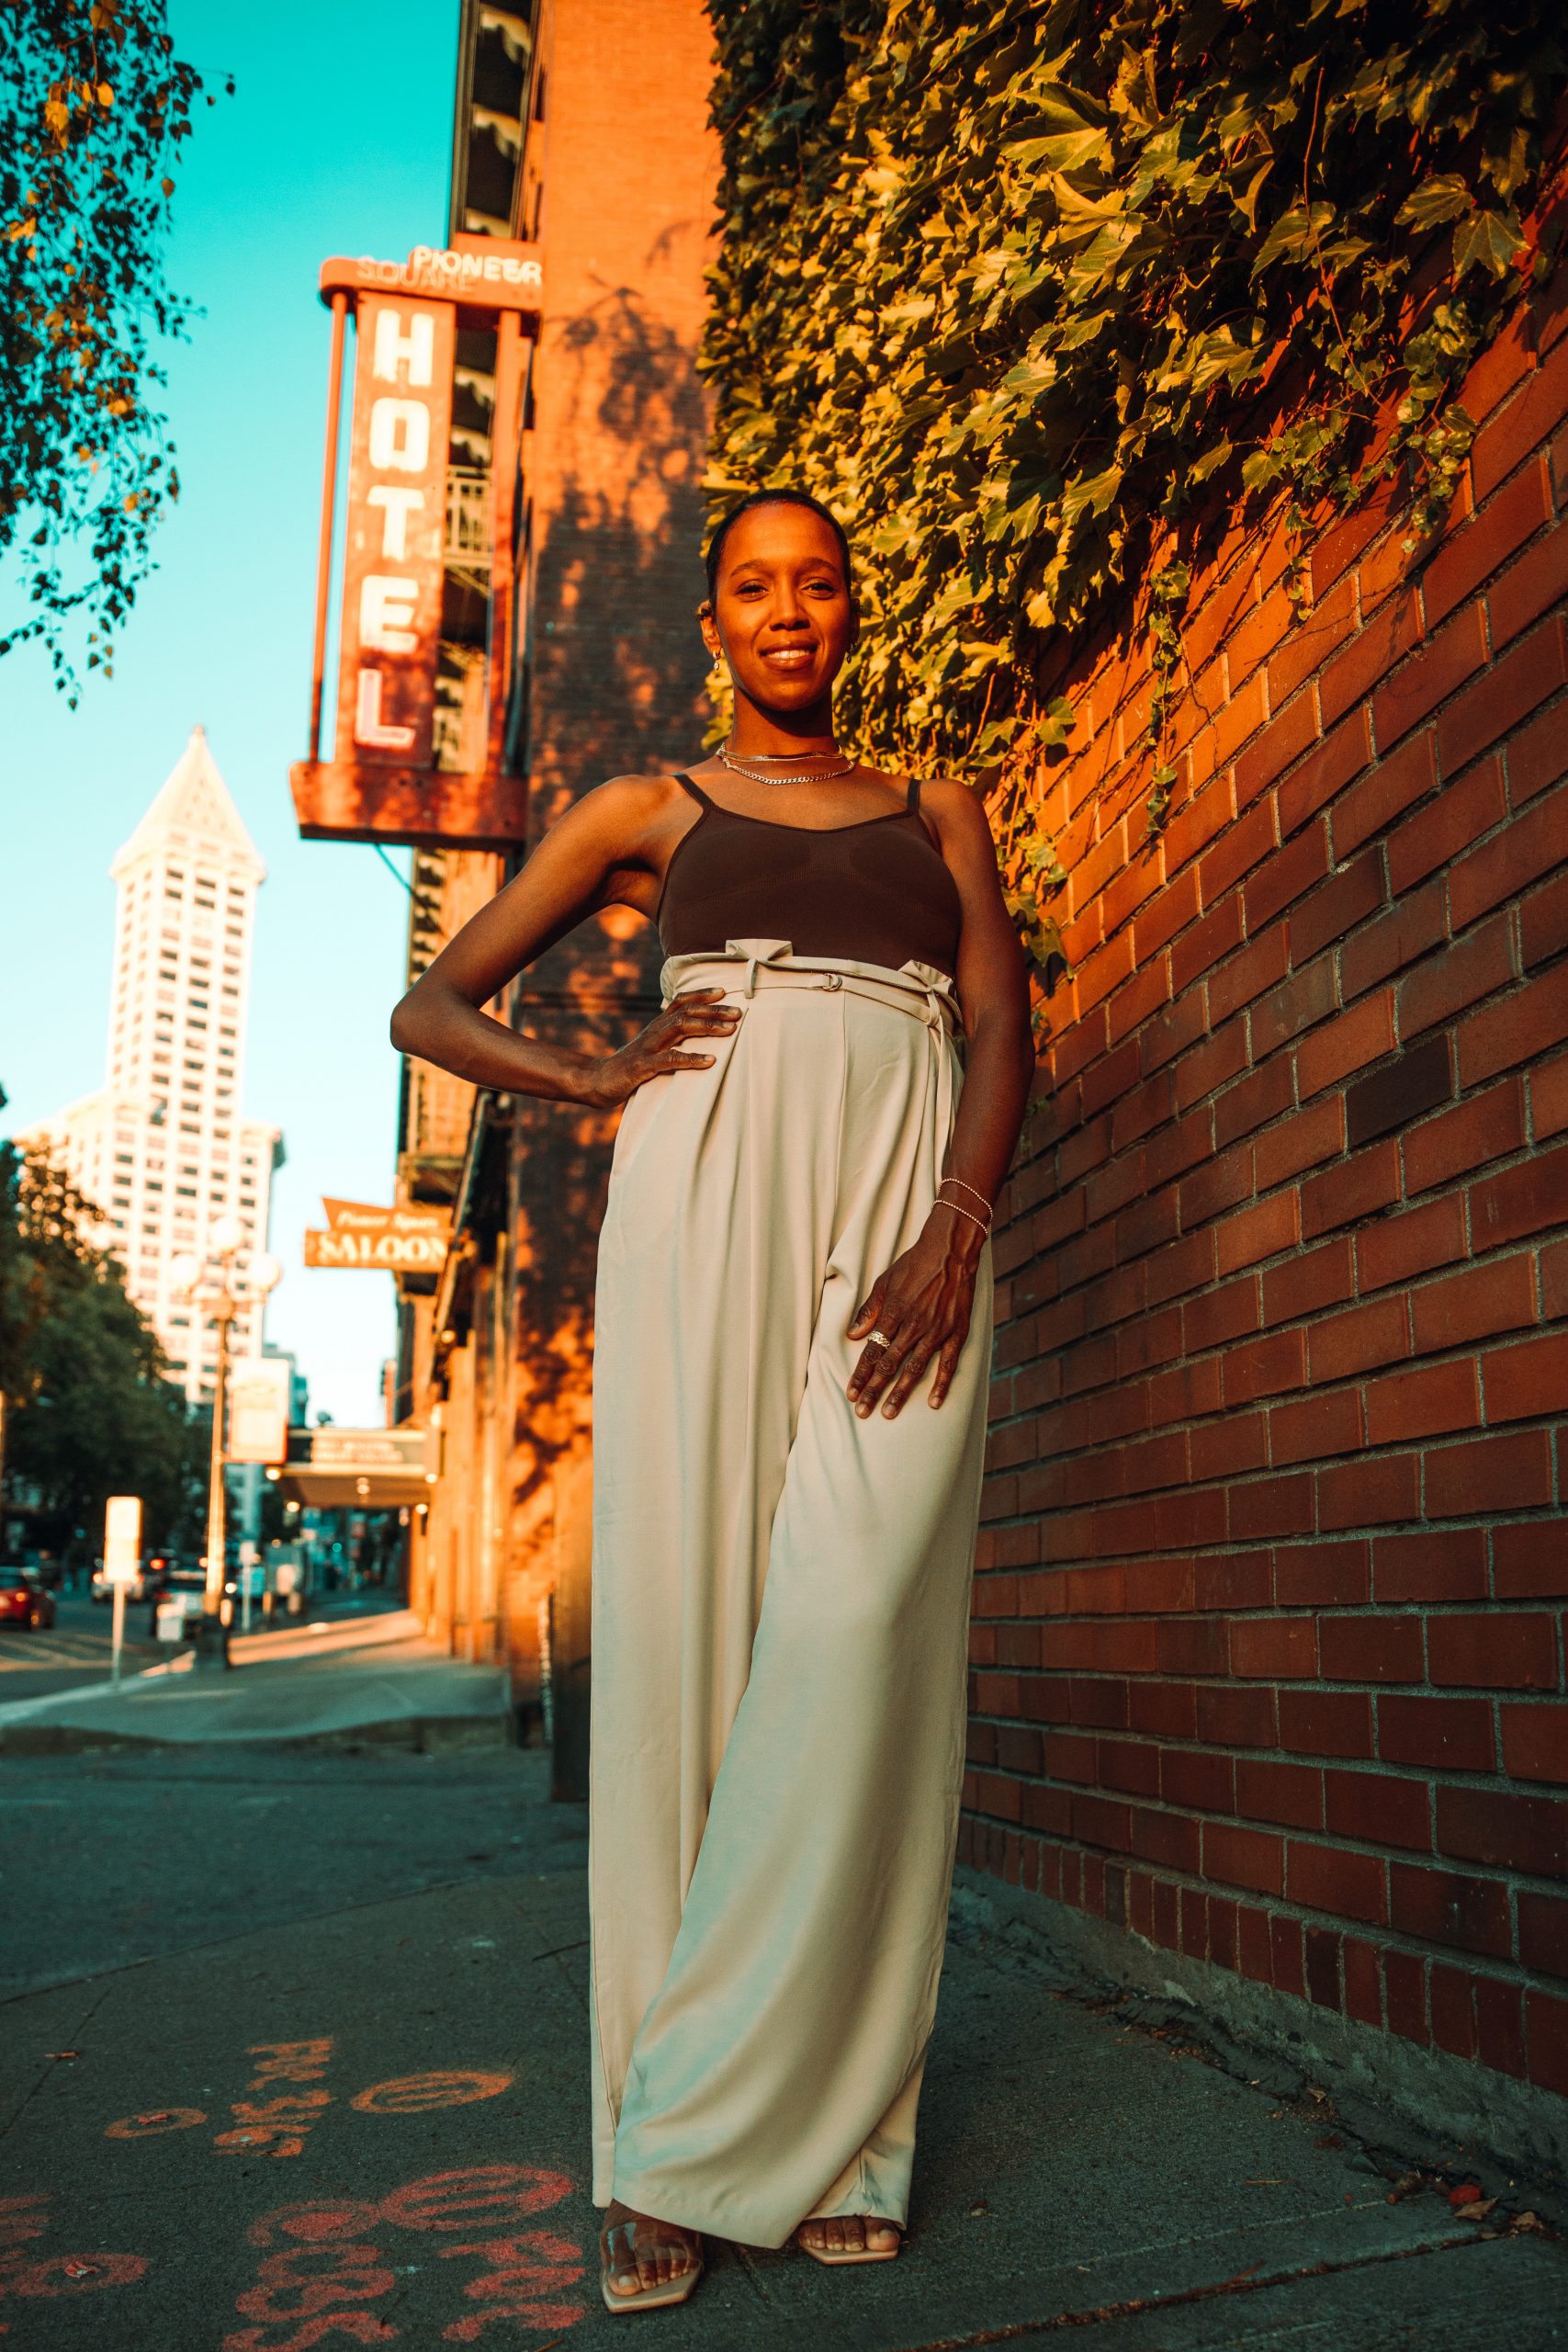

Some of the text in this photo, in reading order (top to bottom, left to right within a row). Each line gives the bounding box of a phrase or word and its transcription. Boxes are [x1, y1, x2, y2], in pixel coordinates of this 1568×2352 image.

[355, 254, 477, 292] SQUARE
[413, 245, 542, 287] PIONEER
[354, 309, 434, 749] HOTEL
[317, 1232, 448, 1264] SALOON
